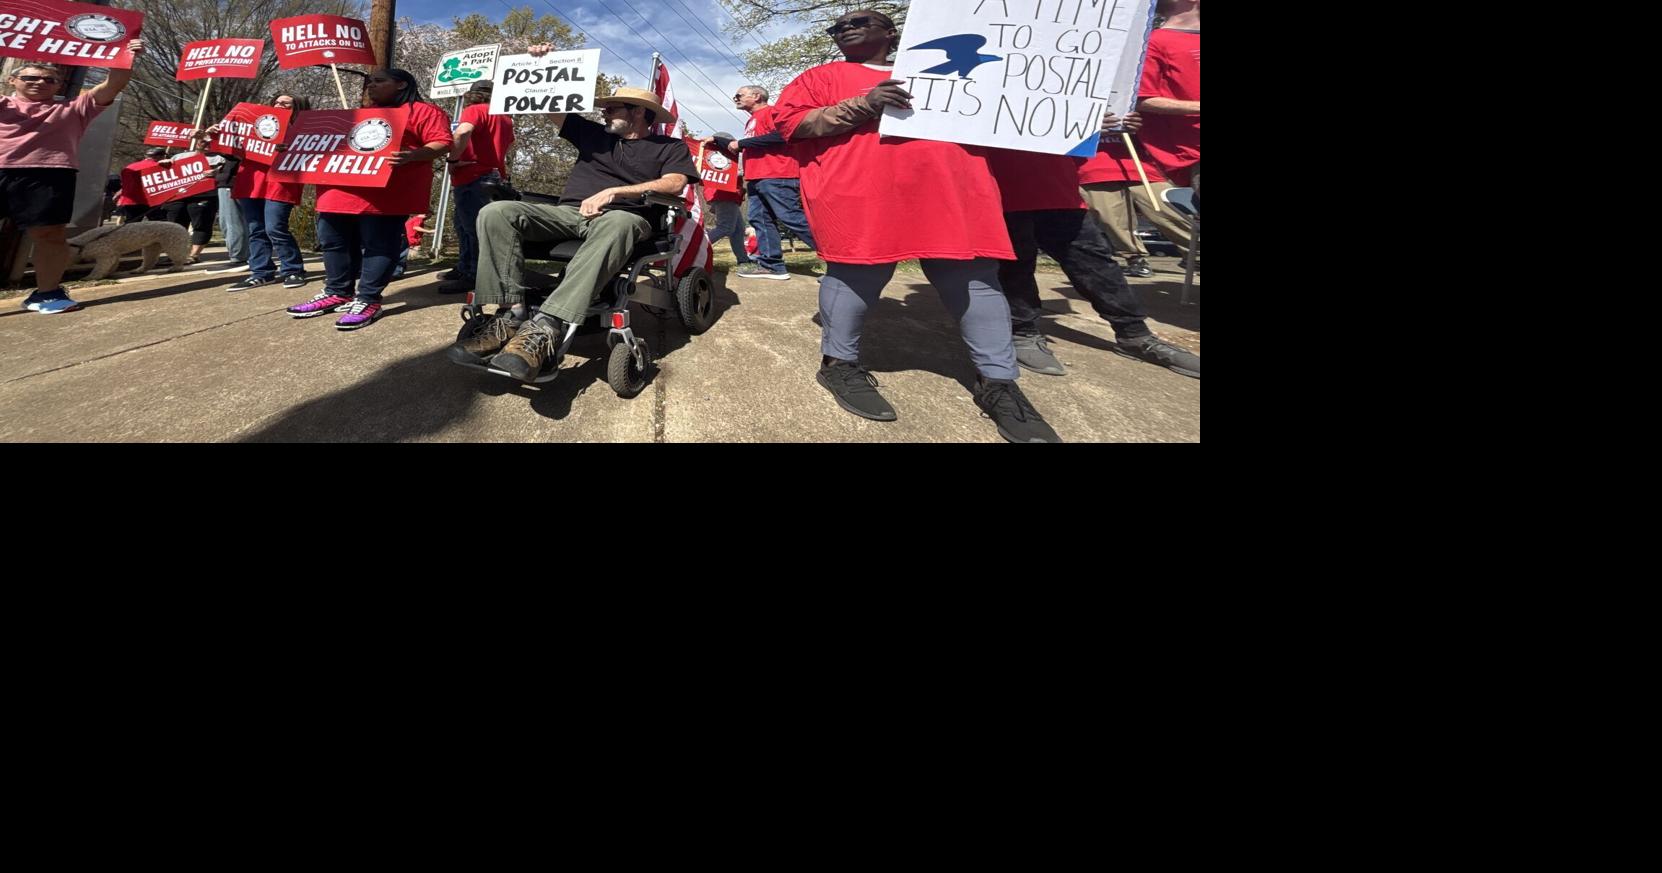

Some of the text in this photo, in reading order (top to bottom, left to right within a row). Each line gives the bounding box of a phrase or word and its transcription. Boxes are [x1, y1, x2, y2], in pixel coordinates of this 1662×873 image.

[281, 23, 362, 43] HELL NO
[989, 23, 1102, 55] TO GO
[37, 38, 120, 60] HELL!
[186, 44, 256, 60] HELL NO
[285, 43, 296, 51] TO
[298, 38, 336, 49] ATTACKS
[339, 39, 351, 47] ON
[194, 58, 254, 67] PRIVATIZATION!
[462, 50, 494, 60] Adopt
[470, 57, 493, 65] Park
[502, 65, 585, 86] POSTAL
[1002, 52, 1107, 100] POSTAL
[503, 93, 586, 112] POWER
[993, 94, 1104, 141] NOW!
[152, 125, 178, 135] HELL
[219, 119, 254, 137] FIGHT
[218, 134, 276, 157] LIKE HELL!
[287, 134, 346, 152] FIGHT
[277, 153, 385, 176] LIKE HELL!
[141, 161, 204, 188] HELL NO
